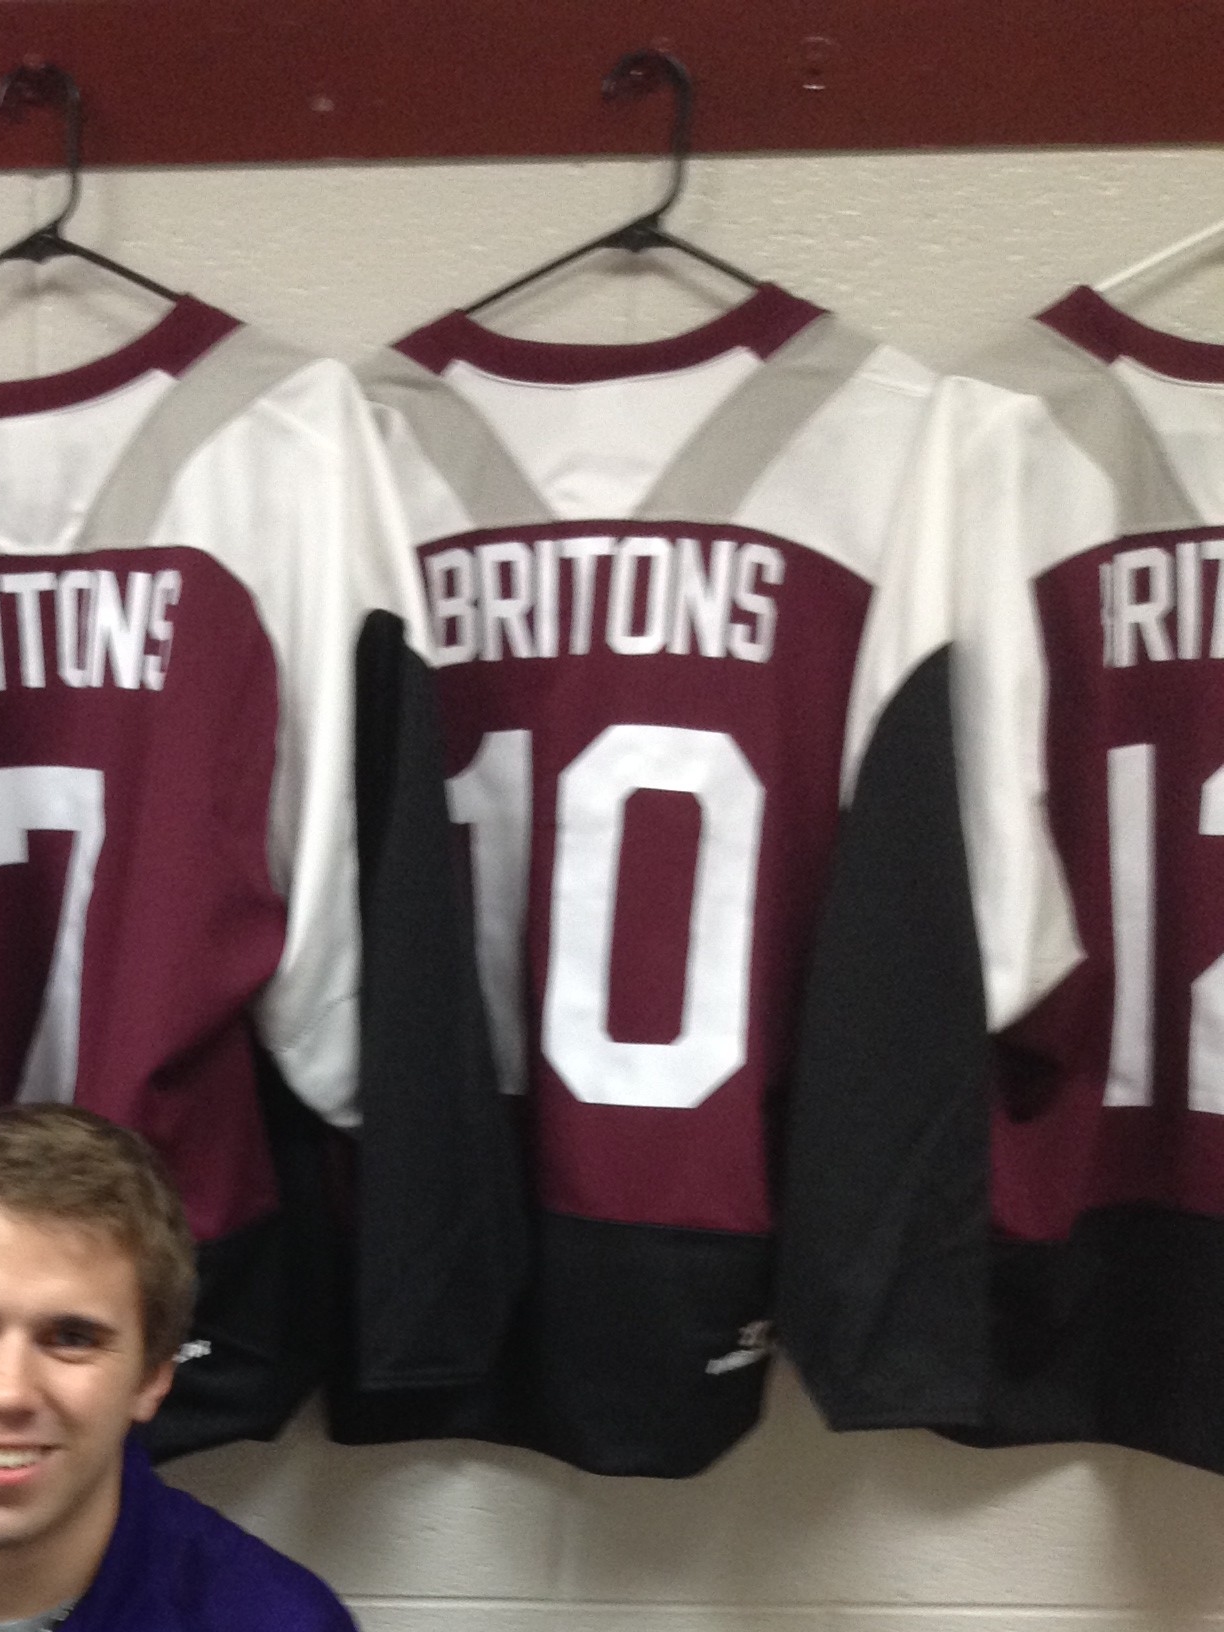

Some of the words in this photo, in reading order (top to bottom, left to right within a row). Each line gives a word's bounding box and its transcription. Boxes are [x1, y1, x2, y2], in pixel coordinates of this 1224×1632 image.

[426, 536, 784, 664] BRITONS
[445, 725, 766, 1109] 10
[1102, 743, 1224, 1115] 1
